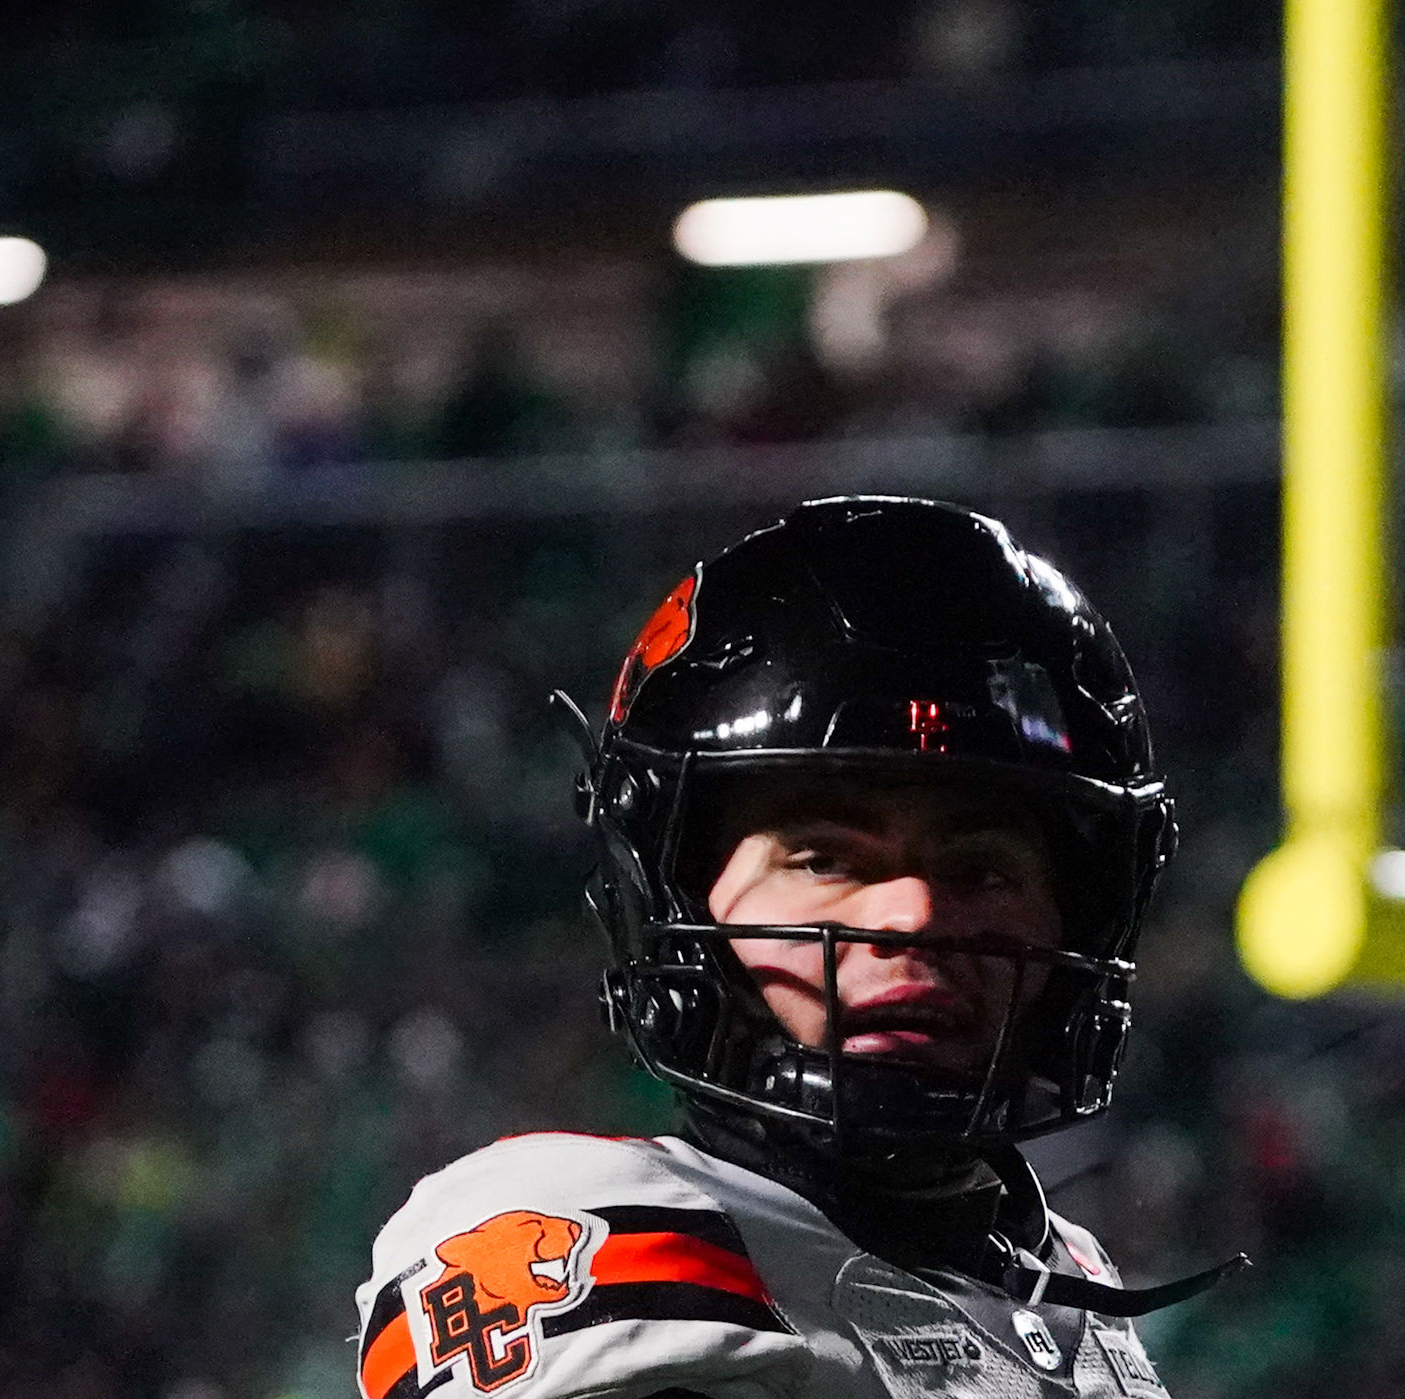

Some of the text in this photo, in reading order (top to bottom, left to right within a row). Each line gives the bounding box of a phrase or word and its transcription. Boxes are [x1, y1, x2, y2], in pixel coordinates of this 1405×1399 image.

[420, 1272, 532, 1392] BC
[1024, 1330, 1055, 1354] CFL
[884, 1338, 962, 1361] WESTJET
[1108, 1348, 1162, 1388] TEL
